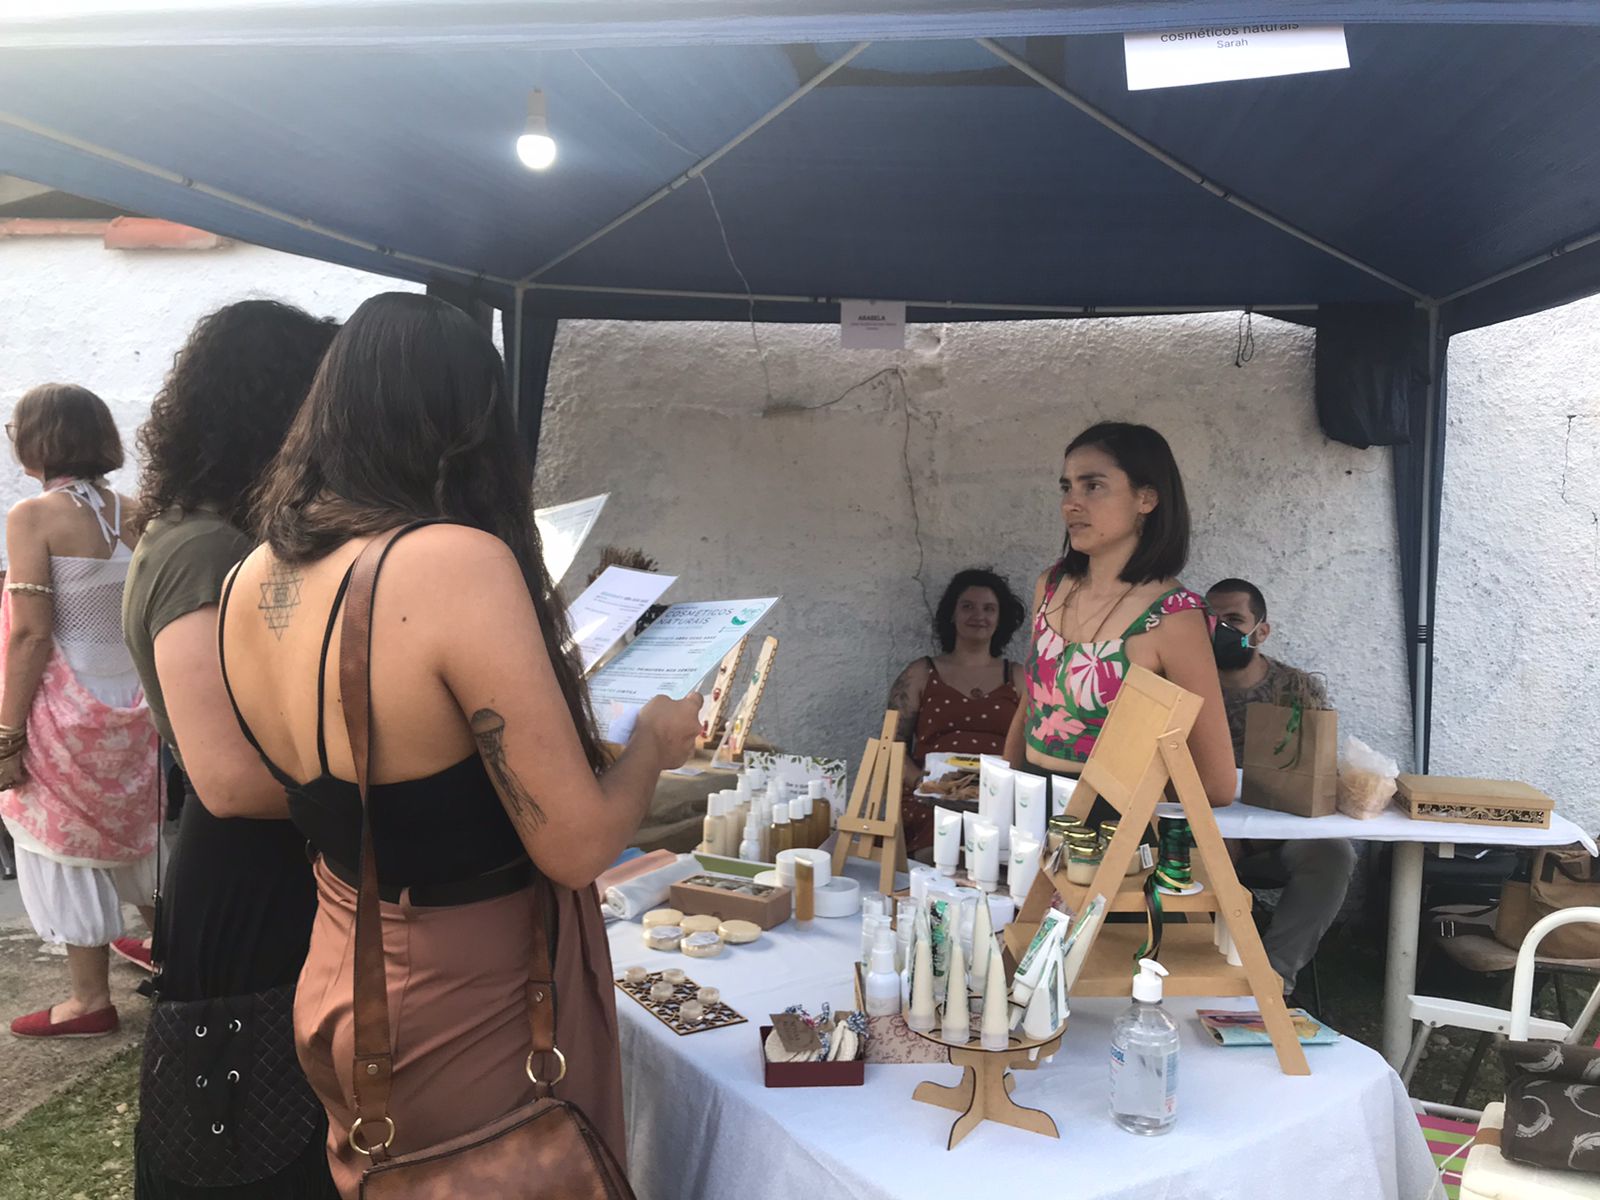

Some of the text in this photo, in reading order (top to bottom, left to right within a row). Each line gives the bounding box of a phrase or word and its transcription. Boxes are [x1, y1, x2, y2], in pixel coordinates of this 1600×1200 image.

[1160, 25, 1239, 43] cosméticos
[1216, 38, 1249, 49] Sarah
[656, 617, 712, 625] NATURAIS
